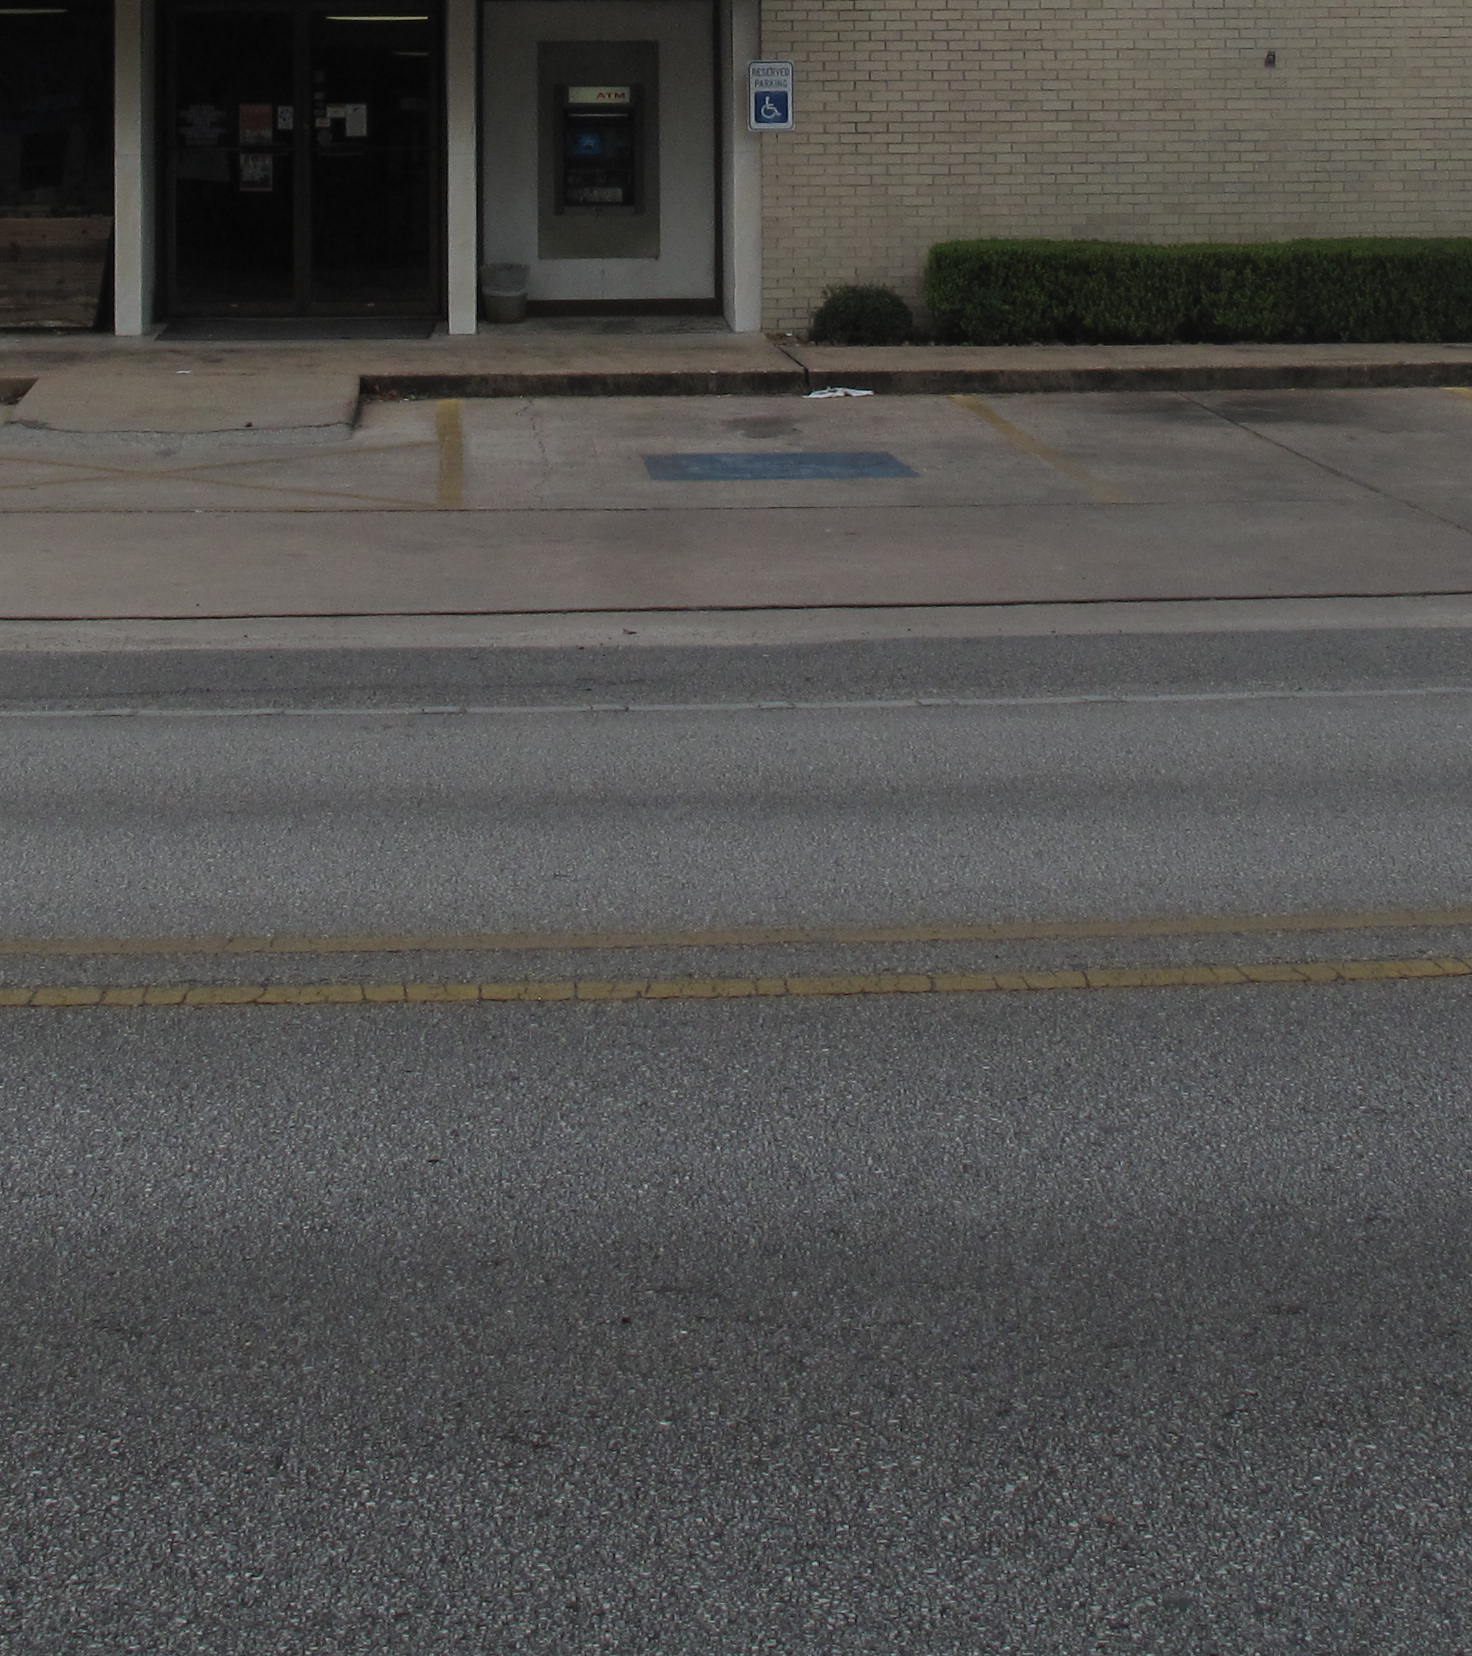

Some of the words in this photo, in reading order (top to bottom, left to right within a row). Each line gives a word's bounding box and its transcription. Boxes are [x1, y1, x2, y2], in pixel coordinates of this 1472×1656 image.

[751, 67, 790, 77] RESERVED
[755, 79, 788, 89] PARKING
[596, 91, 626, 99] ATM
